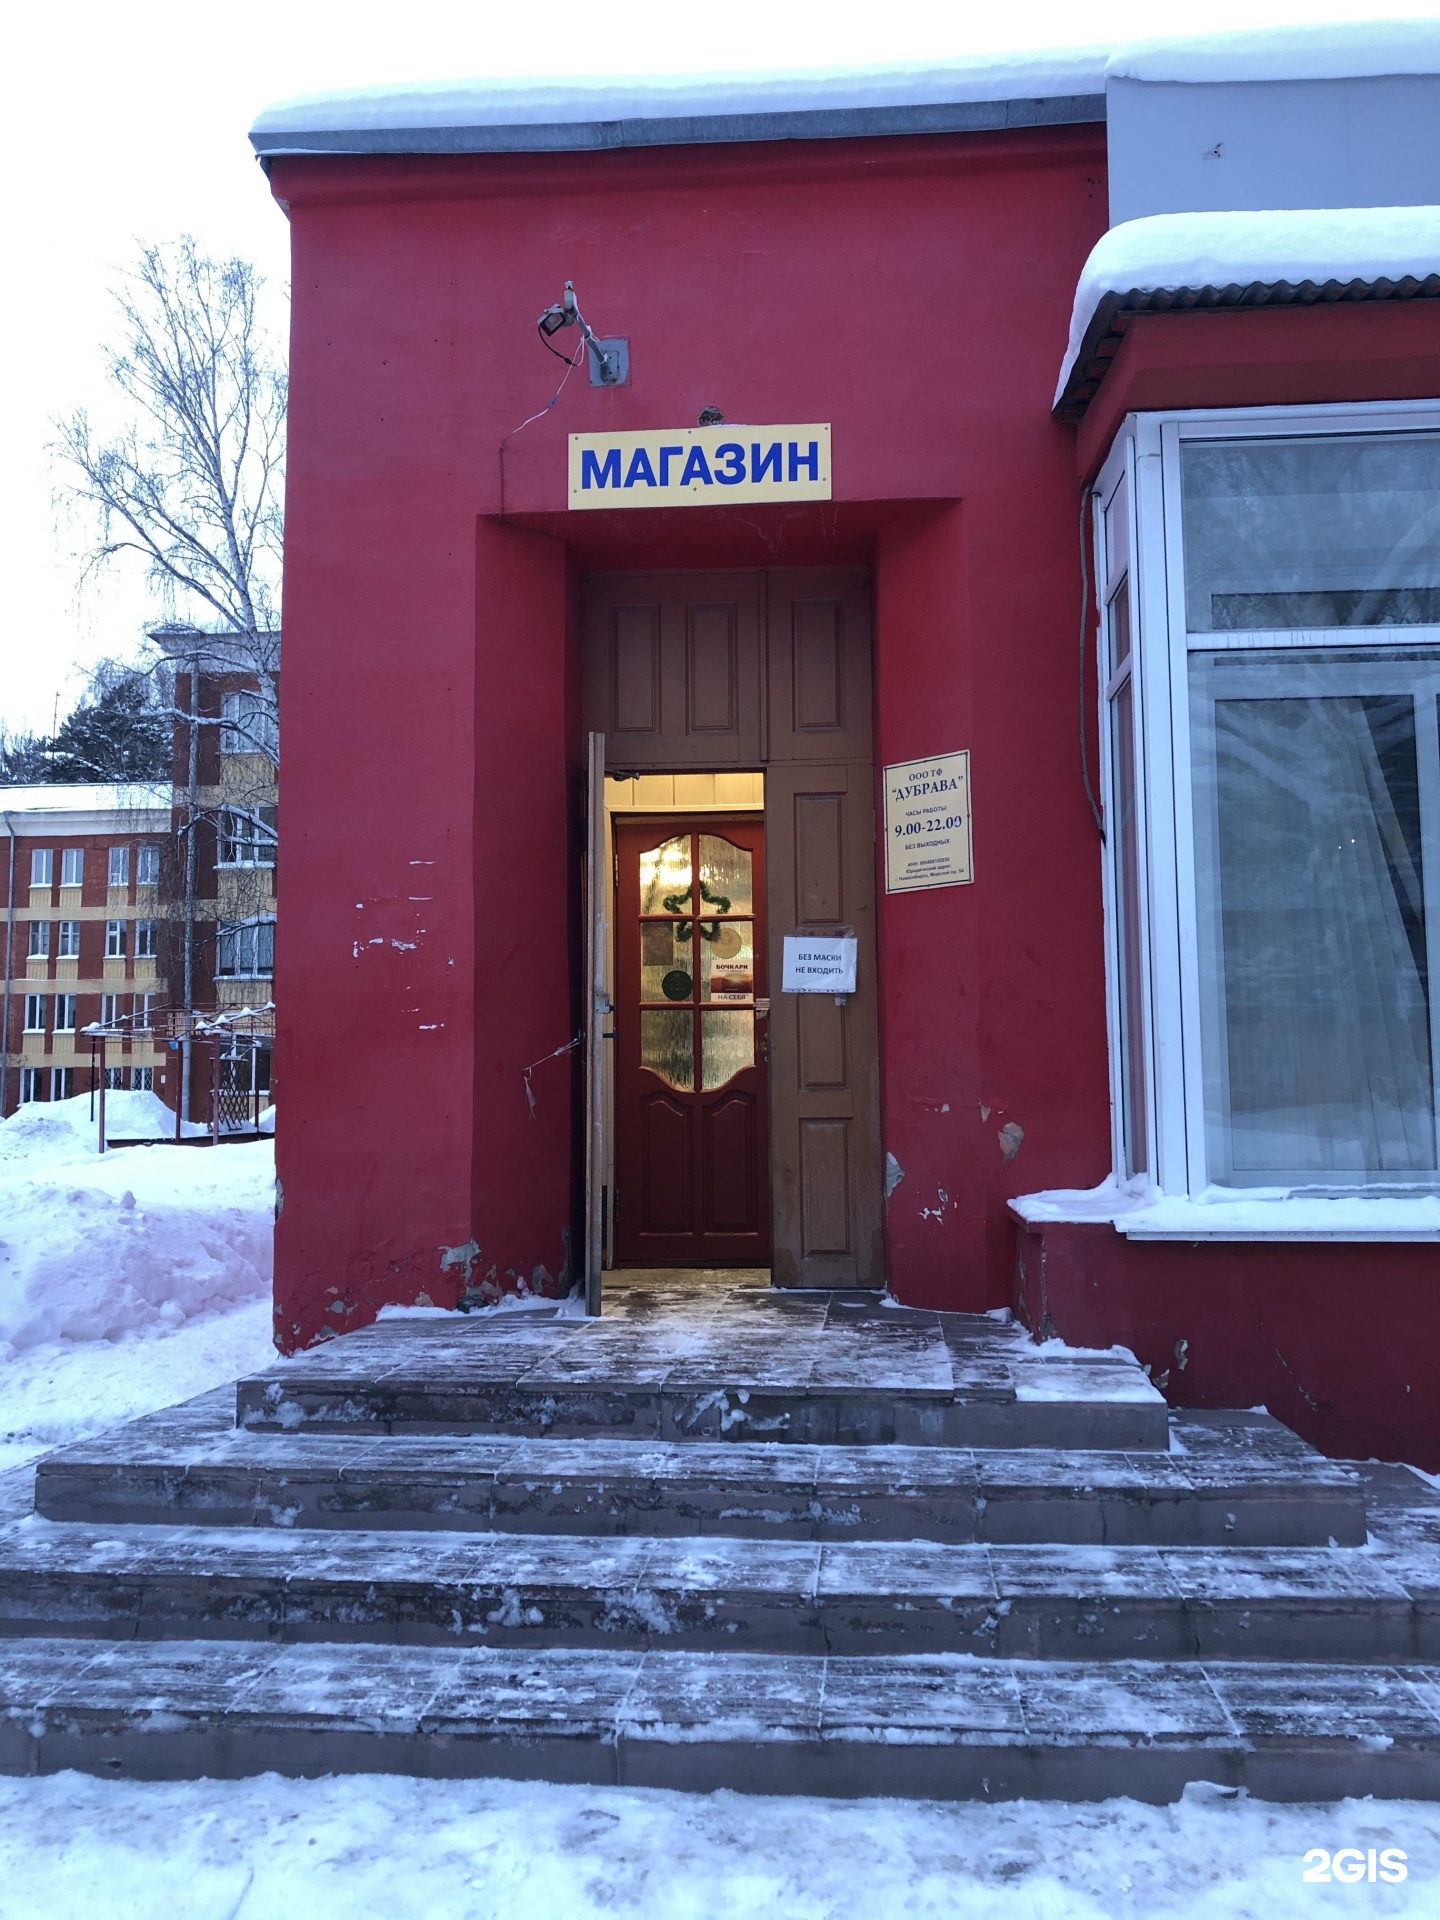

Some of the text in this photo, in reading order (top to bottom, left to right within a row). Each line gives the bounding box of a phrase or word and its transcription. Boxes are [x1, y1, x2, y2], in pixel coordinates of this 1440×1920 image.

[581, 441, 819, 490] МАГАЗИН
[909, 768, 943, 781] ООО ТФ
[905, 809, 921, 817] ЧАСЫ
[917, 838, 950, 849] ВЫХОДНЫХ
[798, 953, 842, 962] БЕЗ МАСКИ
[807, 967, 844, 975] ВХОДИТЬ
